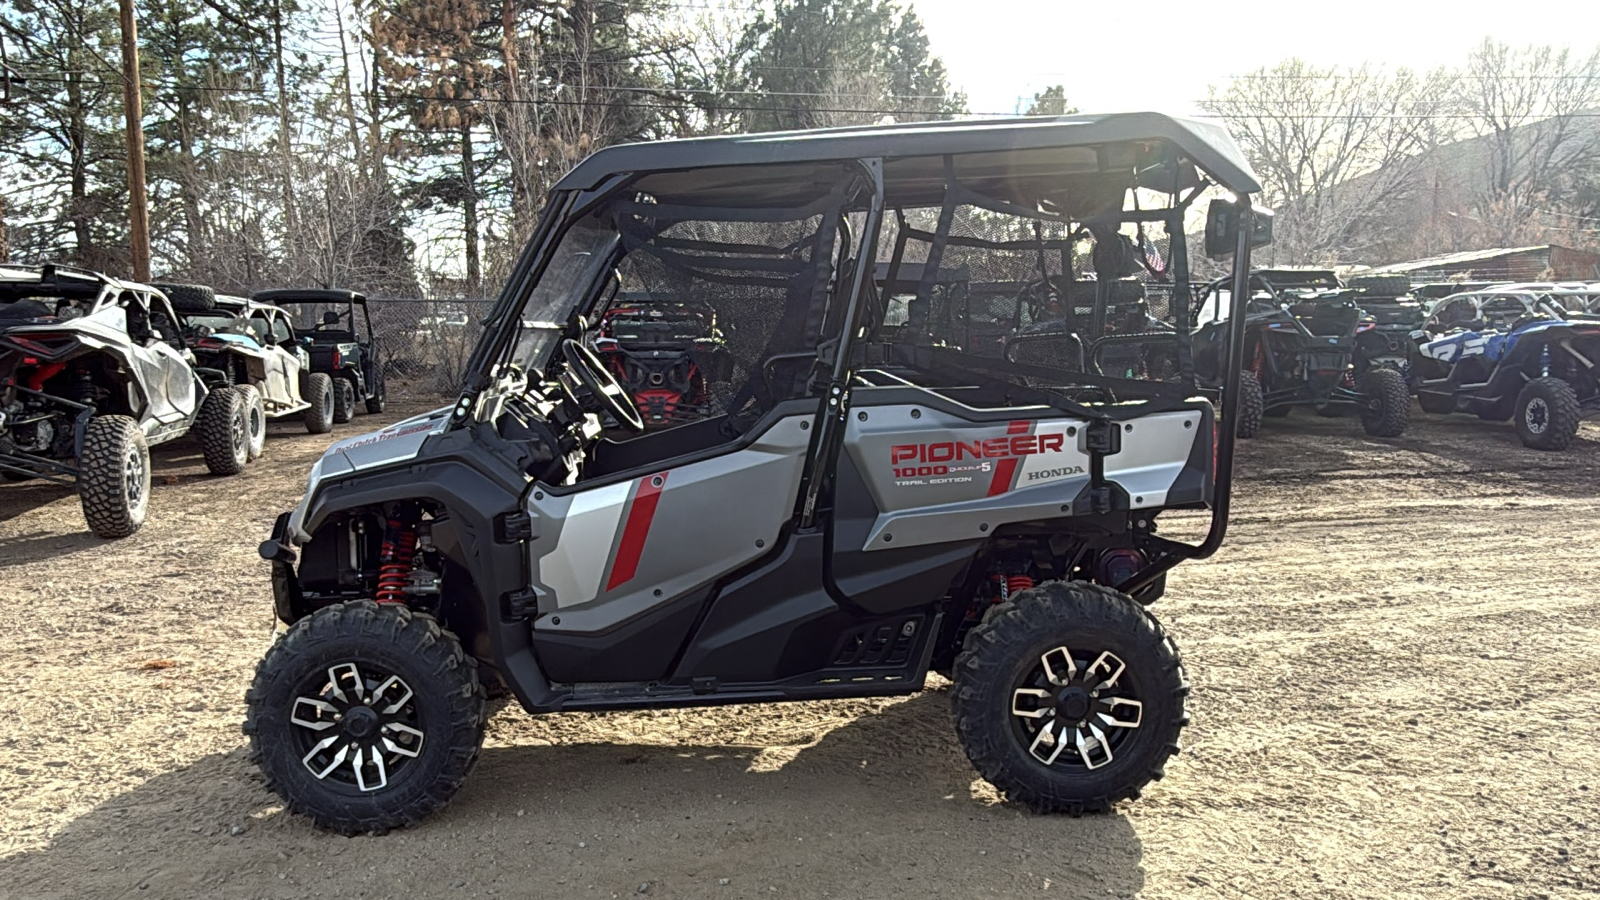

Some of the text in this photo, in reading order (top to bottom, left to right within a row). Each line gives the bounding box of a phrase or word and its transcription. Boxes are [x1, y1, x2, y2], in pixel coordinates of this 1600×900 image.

[891, 433, 1064, 465] PIONEER
[893, 465, 948, 478] 1000
[1027, 465, 1085, 481] HONDA
[929, 476, 972, 485] EDITION
